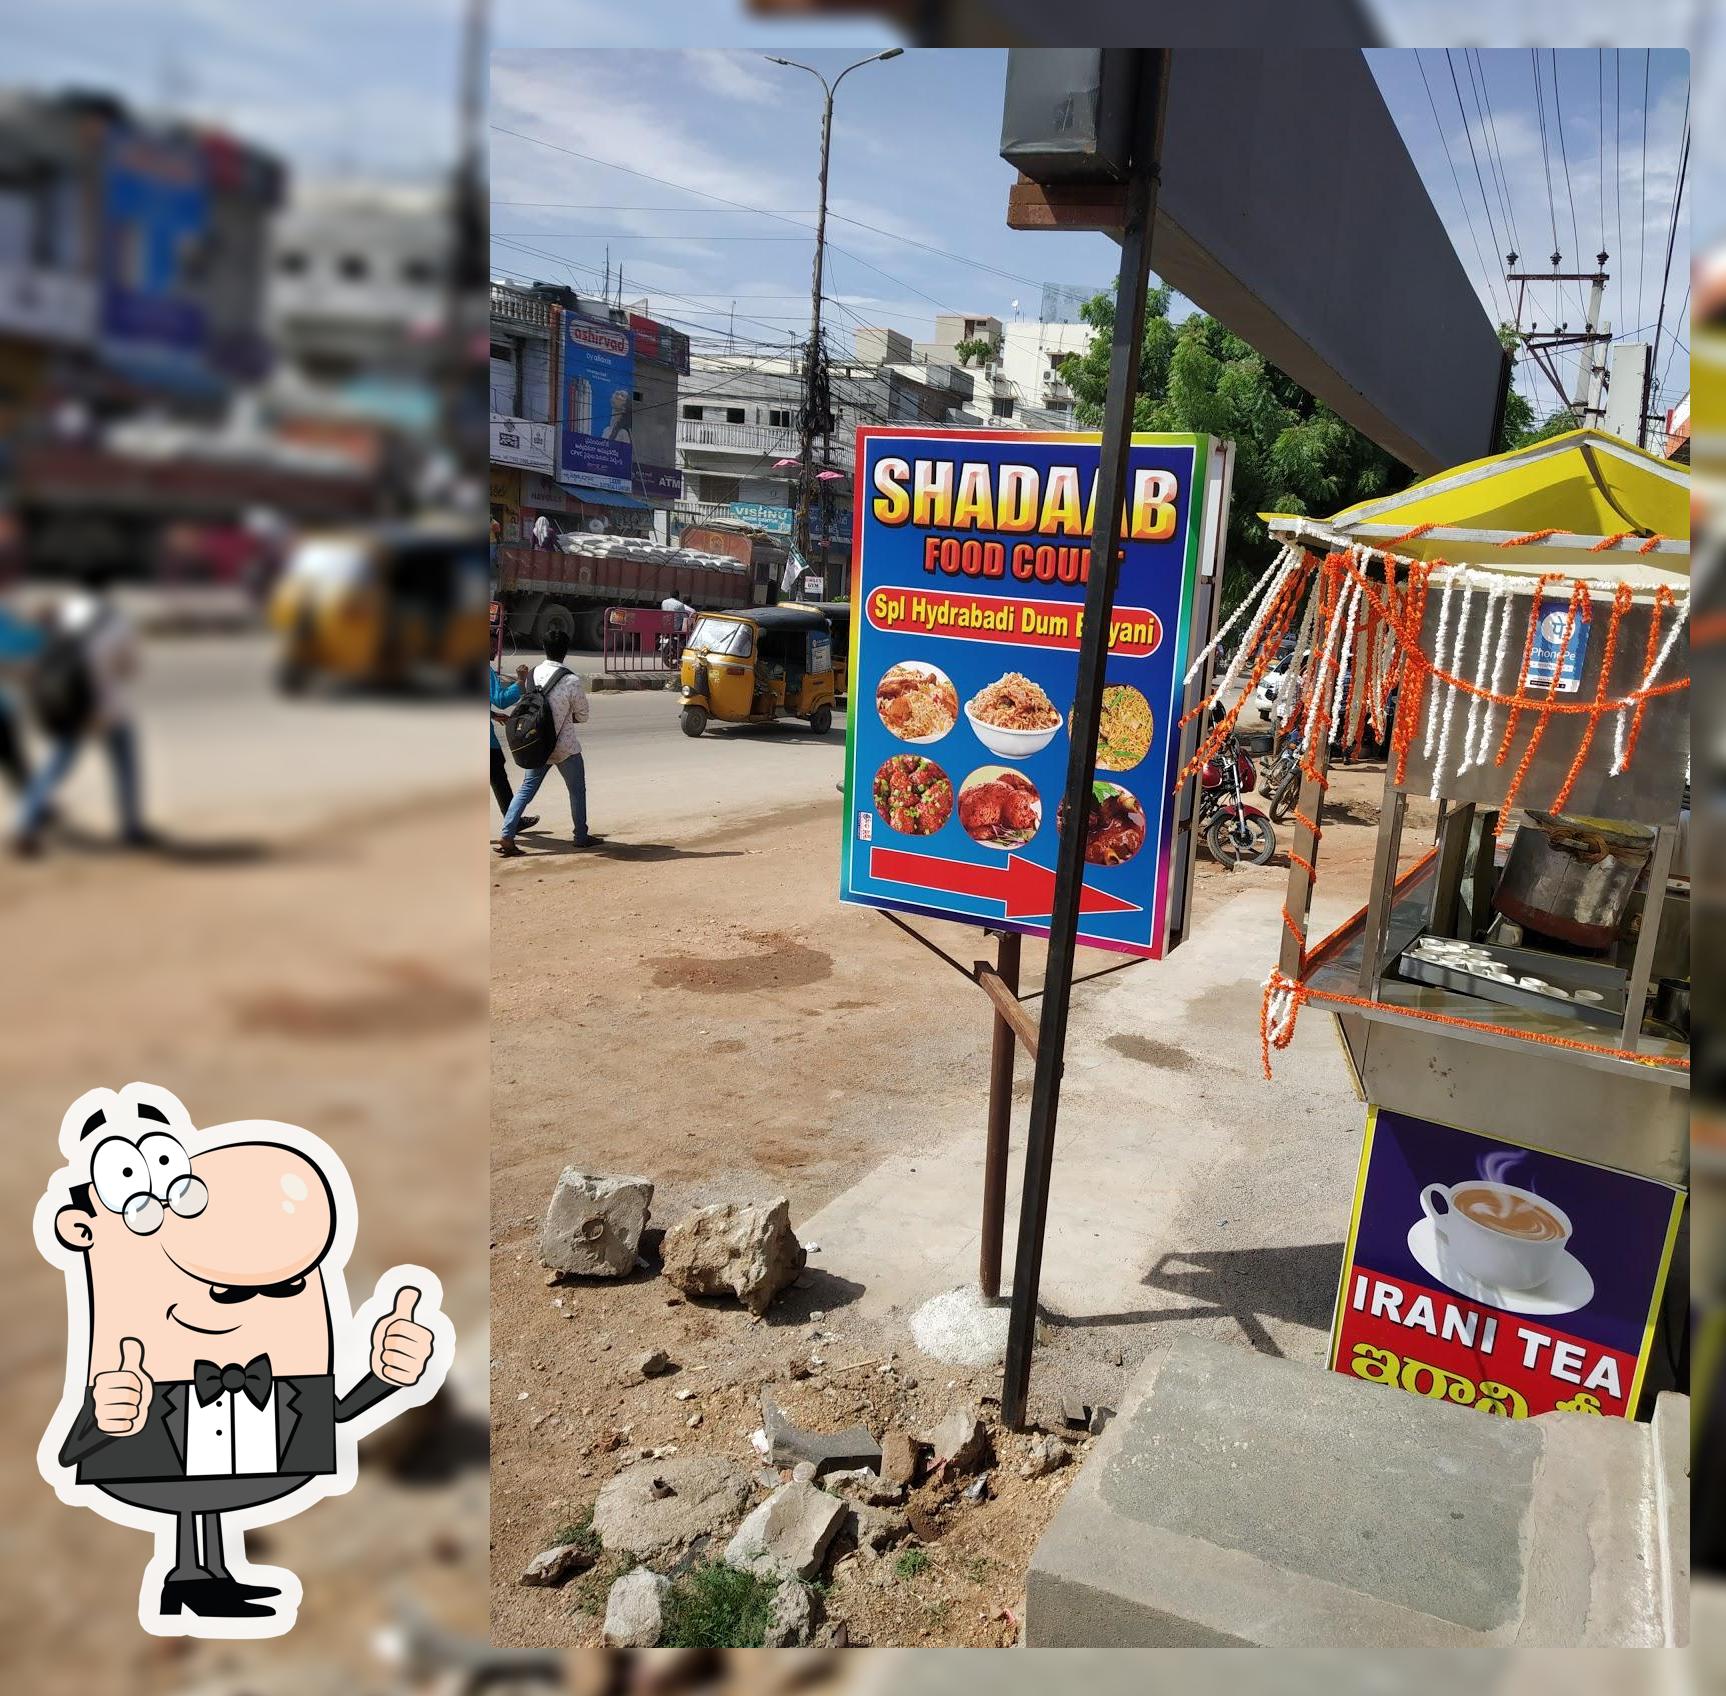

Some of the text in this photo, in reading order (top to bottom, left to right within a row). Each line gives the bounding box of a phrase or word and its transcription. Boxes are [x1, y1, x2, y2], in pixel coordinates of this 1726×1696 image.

[659, 477, 681, 489] ATM
[735, 506, 788, 520] VISHNU
[924, 537, 1125, 584] FOOD COU
[874, 593, 905, 626] Spl
[912, 597, 1015, 632] Hydrabadi
[1021, 607, 1068, 637] Dum
[1351, 1274, 1623, 1400] IRANI TEA
